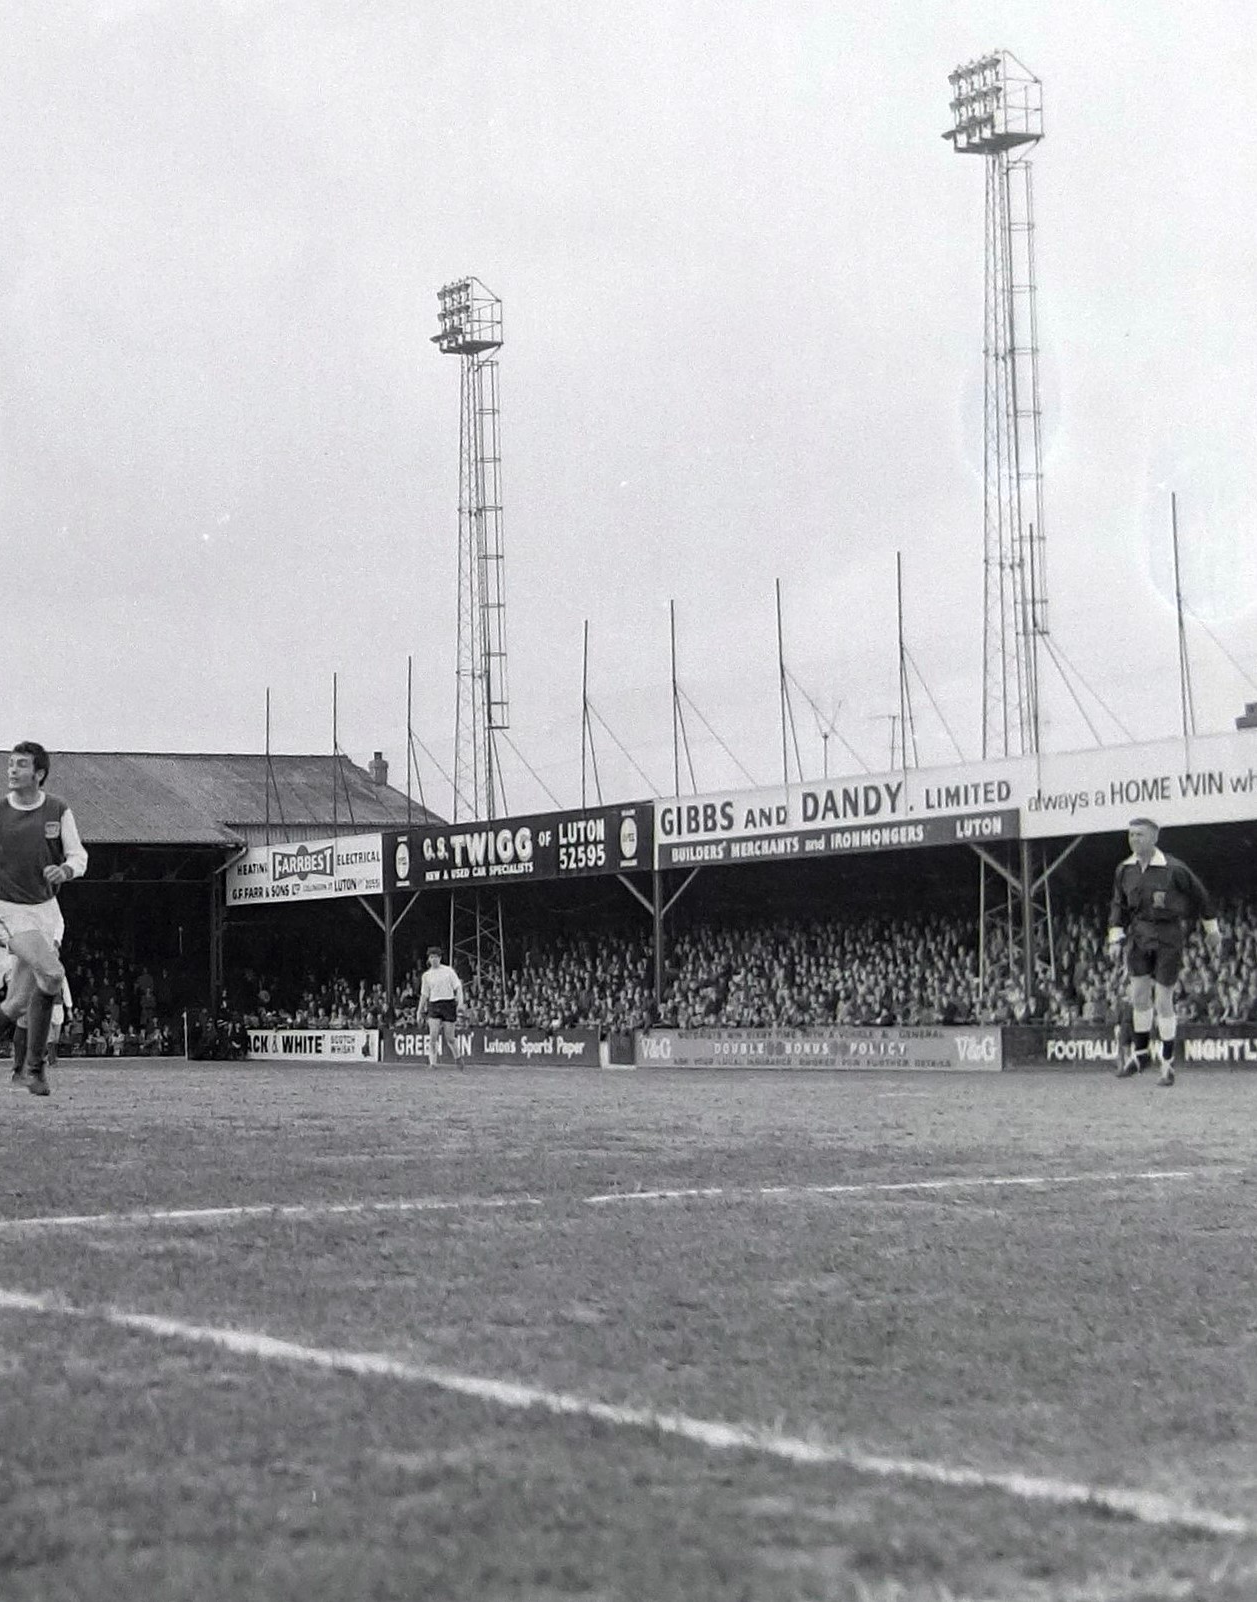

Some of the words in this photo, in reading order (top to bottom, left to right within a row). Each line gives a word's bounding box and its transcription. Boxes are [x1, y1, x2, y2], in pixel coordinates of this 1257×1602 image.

[1028, 788, 1089, 816] always
[1094, 789, 1106, 807] a
[1110, 776, 1171, 805] HOME
[1179, 771, 1224, 798] WIN
[660, 801, 734, 836] GIBBS
[744, 805, 788, 829] AND
[925, 781, 1011, 810] LIMITED
[558, 818, 605, 845] LUTON
[731, 836, 799, 858] MERCHANTS
[805, 834, 825, 851] and
[830, 824, 924, 850] IRONMONGERS
[956, 816, 1002, 838] LUTON
[337, 851, 380, 866] ELECTRICAL
[450, 827, 533, 867] TWIGG
[538, 831, 551, 847] OF
[559, 843, 606, 869] 52595
[275, 848, 332, 879] FARRBEST
[425, 869, 440, 882] NEW
[451, 867, 469, 879] USED
[473, 864, 486, 877] CAR
[489, 861, 534, 875] SPECIALISTS
[244, 886, 264, 898] FARR
[271, 884, 290, 897] SONS
[334, 878, 357, 892] LUTON
[246, 1035, 269, 1053] ACK
[557, 1036, 585, 1059] Paper
[642, 1037, 671, 1059] V&G
[714, 1042, 764, 1055] DOUBLE
[785, 1042, 829, 1055] BONUS
[849, 1042, 906, 1055] POLICY
[954, 1036, 997, 1062] V&G
